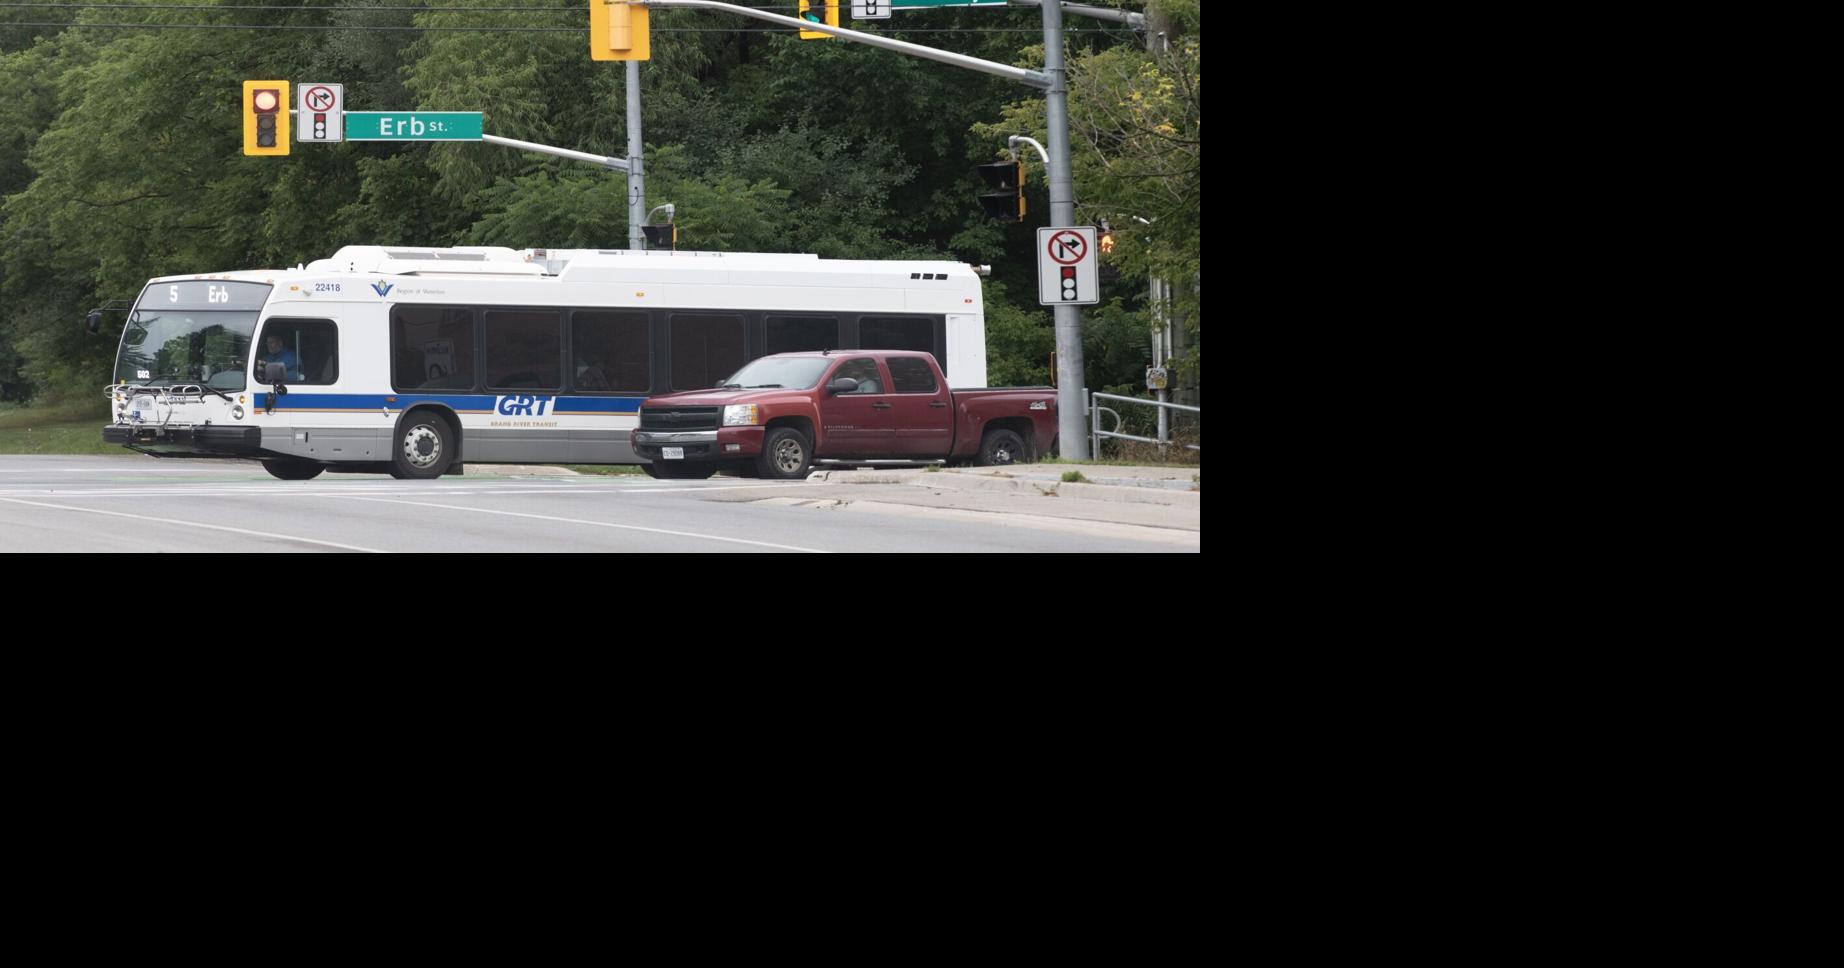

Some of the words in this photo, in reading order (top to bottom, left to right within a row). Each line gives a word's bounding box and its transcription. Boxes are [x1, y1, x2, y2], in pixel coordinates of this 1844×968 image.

[380, 116, 425, 136] Erb
[169, 285, 179, 303] 5
[208, 285, 229, 303] Erb
[314, 282, 341, 292] 22418
[498, 393, 552, 416] GRT
